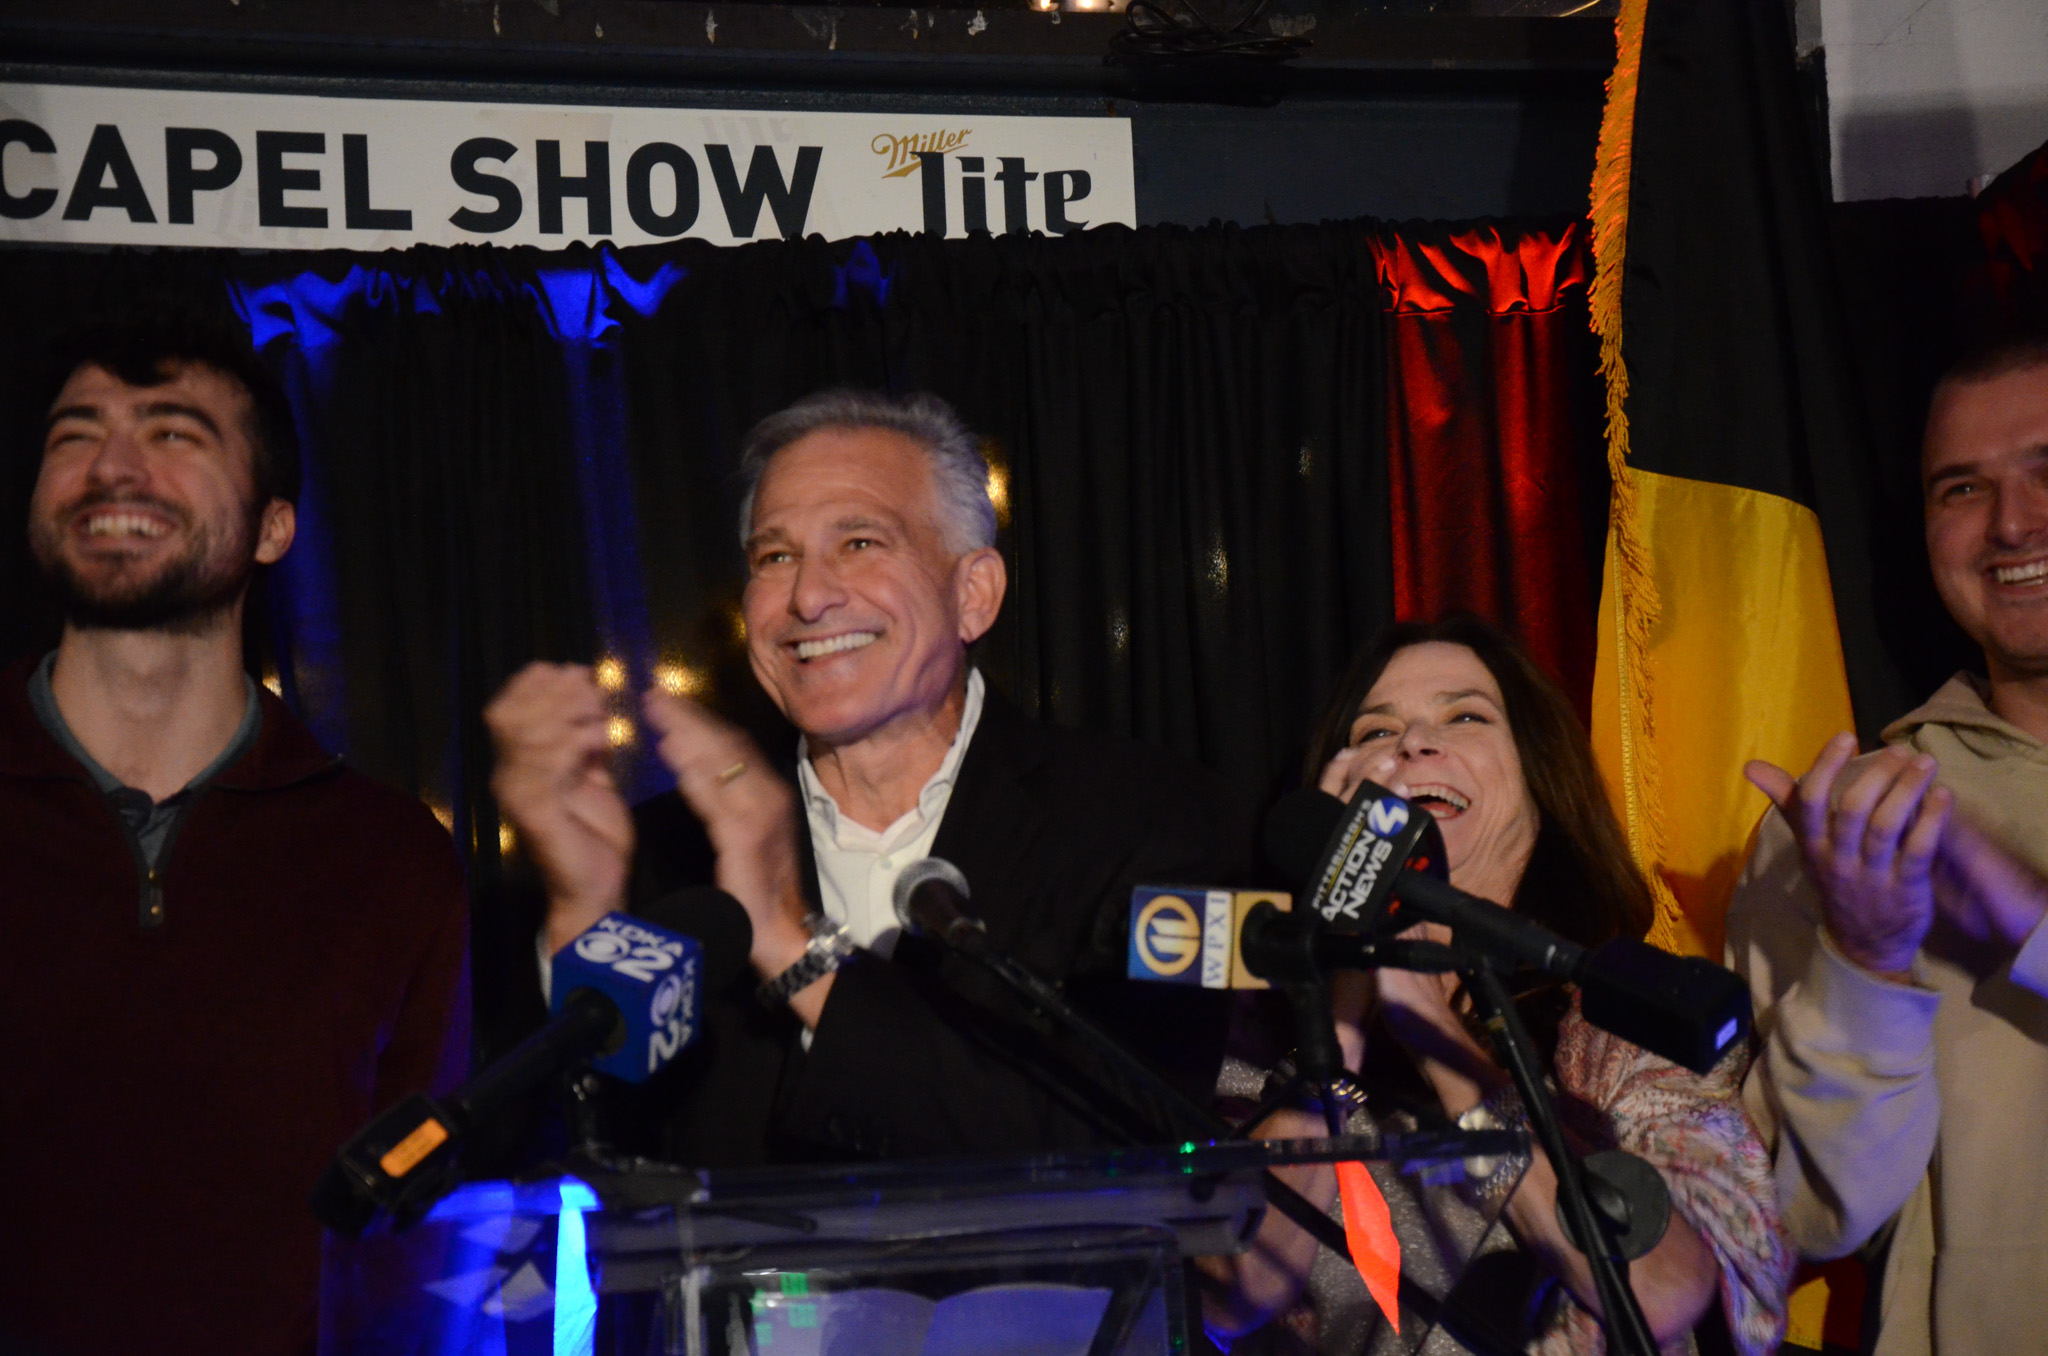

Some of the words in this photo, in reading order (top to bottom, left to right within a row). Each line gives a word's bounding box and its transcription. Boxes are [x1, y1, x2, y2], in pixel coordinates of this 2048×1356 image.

[0, 119, 413, 231] CAPEL
[448, 137, 824, 238] SHOW
[871, 127, 973, 179] Miller
[909, 151, 1092, 239] lite
[1321, 829, 1377, 922] ACTION
[1342, 838, 1393, 920] NEWS
[598, 917, 684, 959] KDKA
[612, 945, 675, 983] 2
[1204, 897, 1227, 983] WPXI
[648, 1020, 680, 1074] 2
